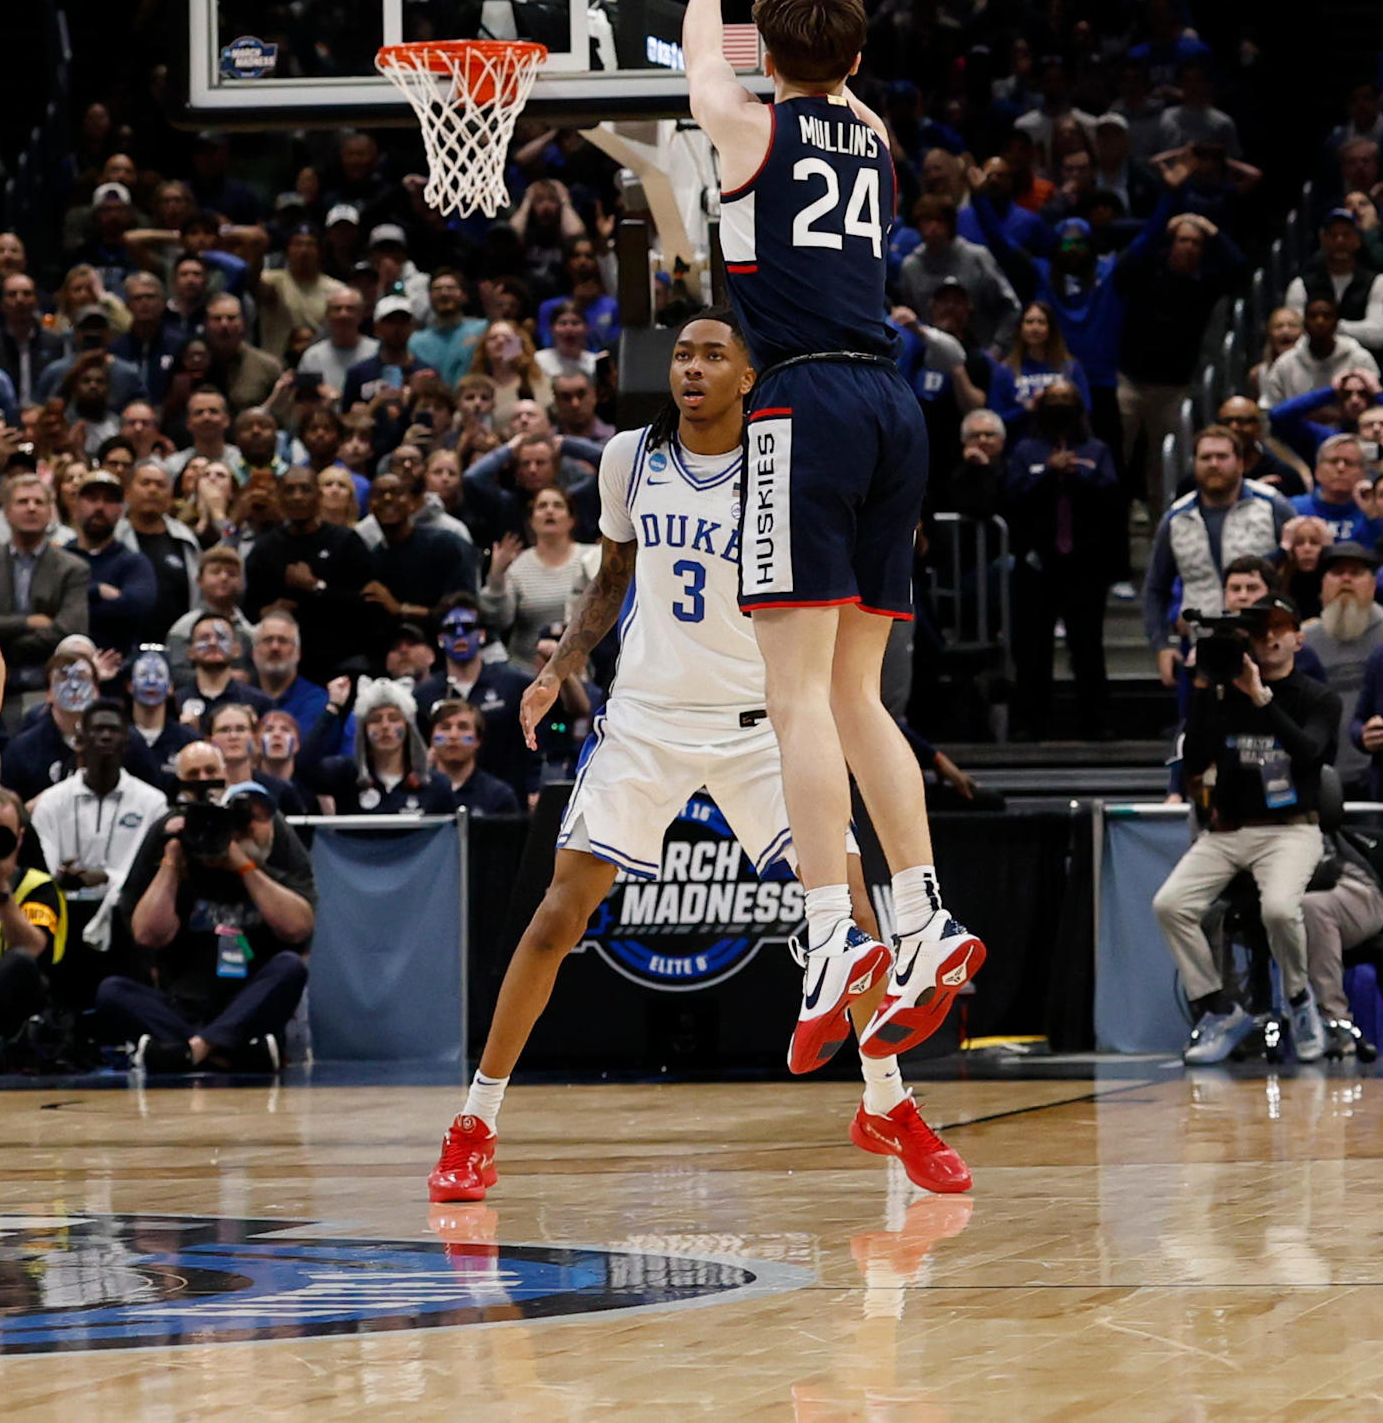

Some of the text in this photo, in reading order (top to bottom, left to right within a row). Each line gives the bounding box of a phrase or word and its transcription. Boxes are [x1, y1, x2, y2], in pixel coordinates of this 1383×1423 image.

[798, 115, 878, 159] MULLINS
[792, 157, 882, 259] 24
[756, 433, 775, 586] HUSKIES
[673, 559, 706, 624] 3
[615, 840, 743, 882] RCH
[620, 881, 805, 925] MADNESS
[649, 955, 692, 975] ELITE
